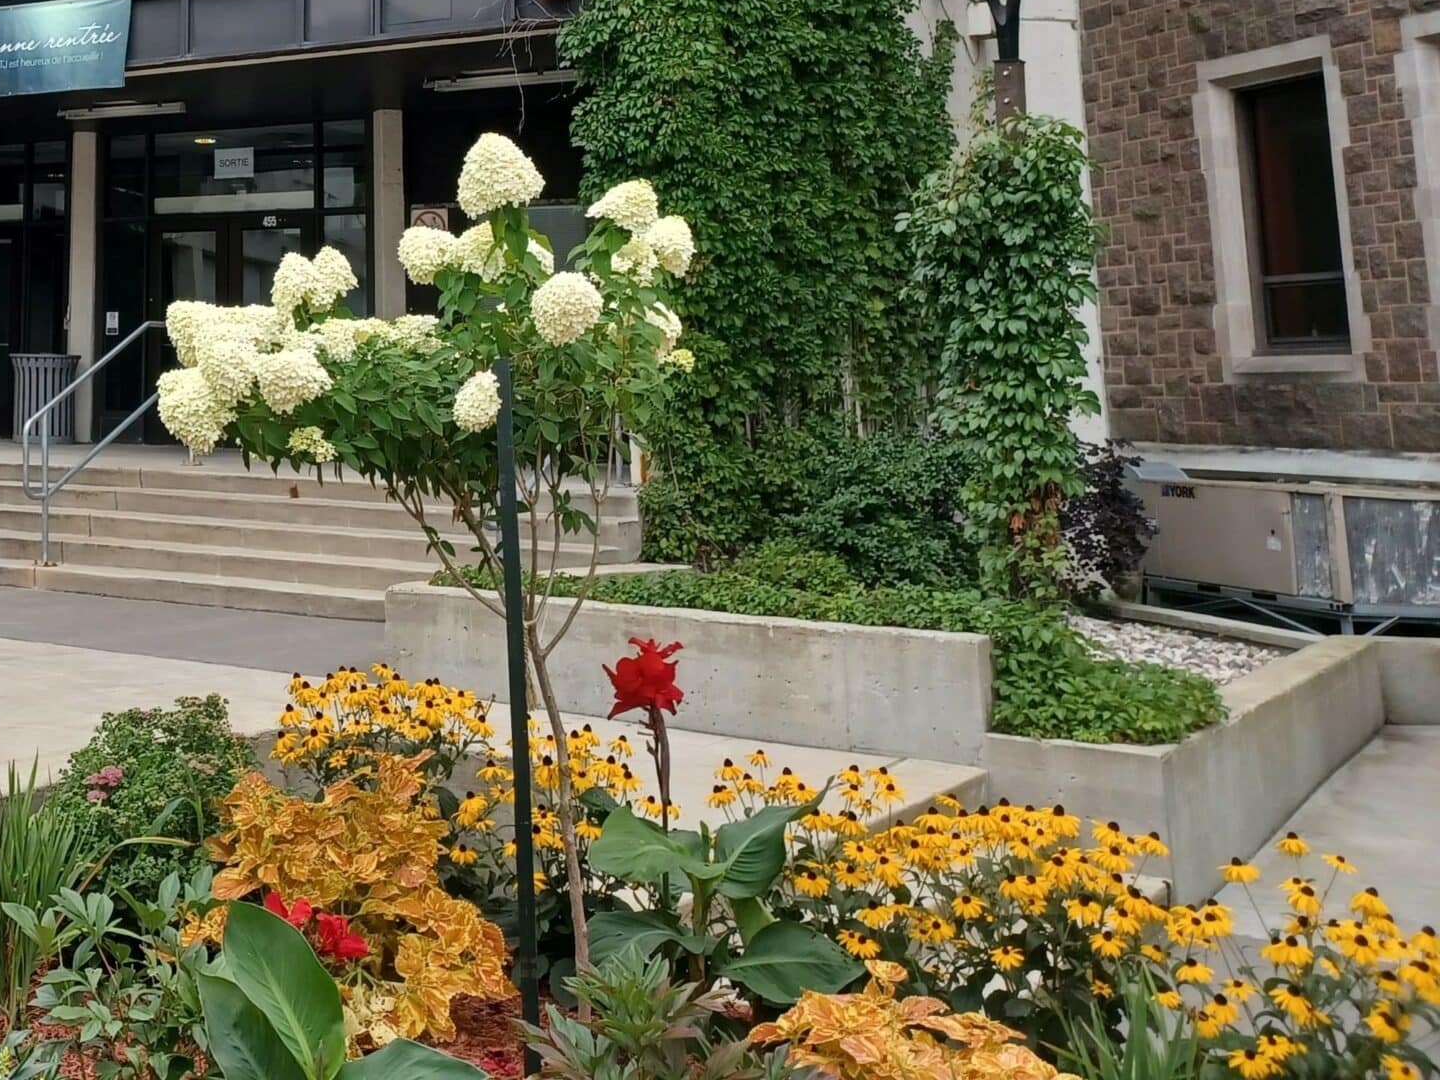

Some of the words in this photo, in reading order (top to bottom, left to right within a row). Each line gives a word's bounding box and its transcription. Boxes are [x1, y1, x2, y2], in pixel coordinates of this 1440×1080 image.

[42, 21, 122, 50] rentrée
[20, 54, 51, 67] heureux
[219, 158, 249, 168] SORTIE
[262, 215, 277, 227] 455
[1169, 485, 1195, 499] YORK
